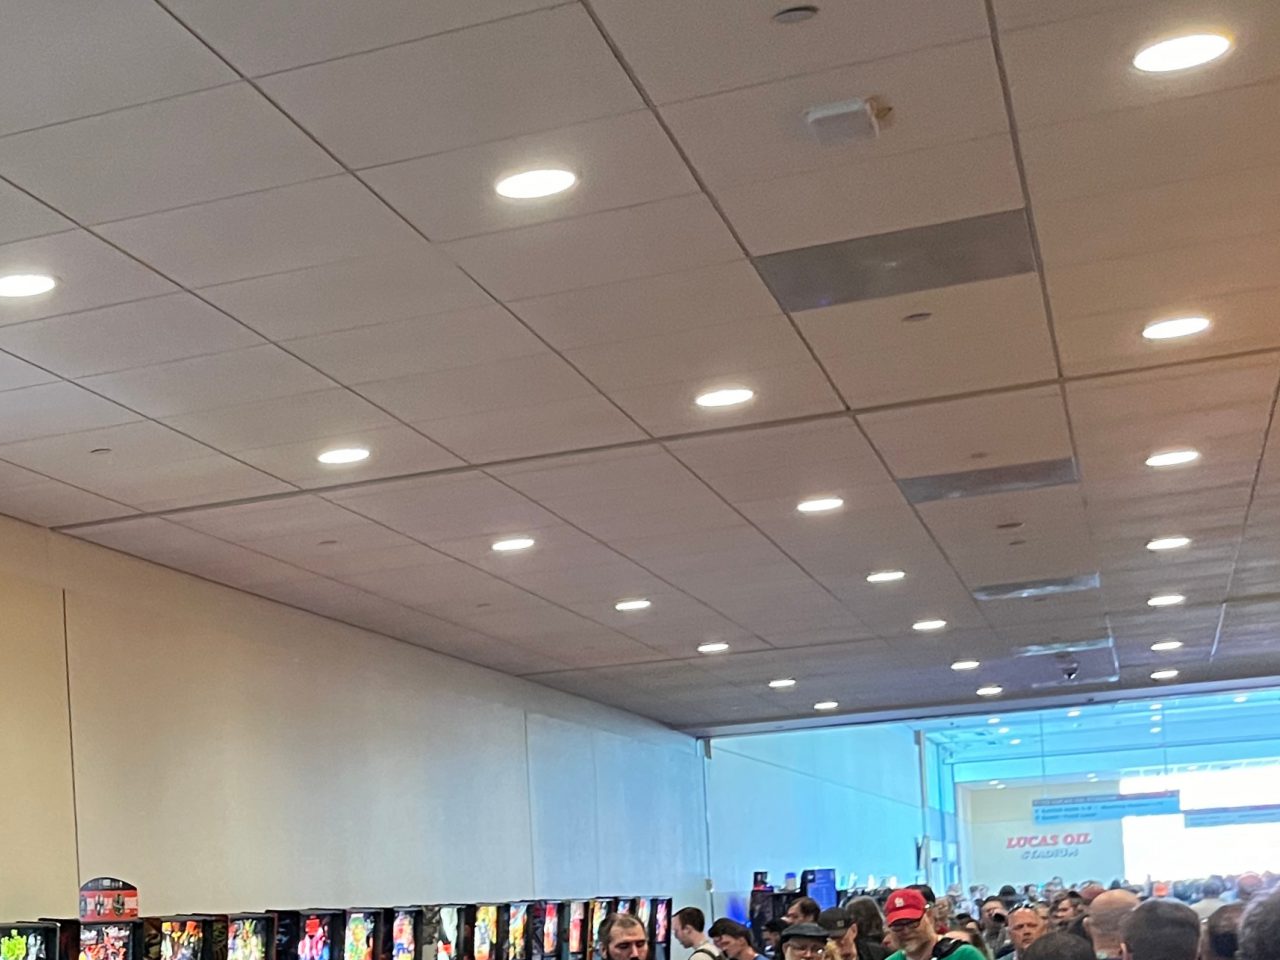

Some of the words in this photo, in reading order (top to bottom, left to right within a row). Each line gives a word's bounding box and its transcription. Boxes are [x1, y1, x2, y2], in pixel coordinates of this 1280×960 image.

[1006, 834, 1058, 850] LUCAS
[1062, 833, 1092, 846] OIL
[1020, 848, 1079, 860] STADIUM
